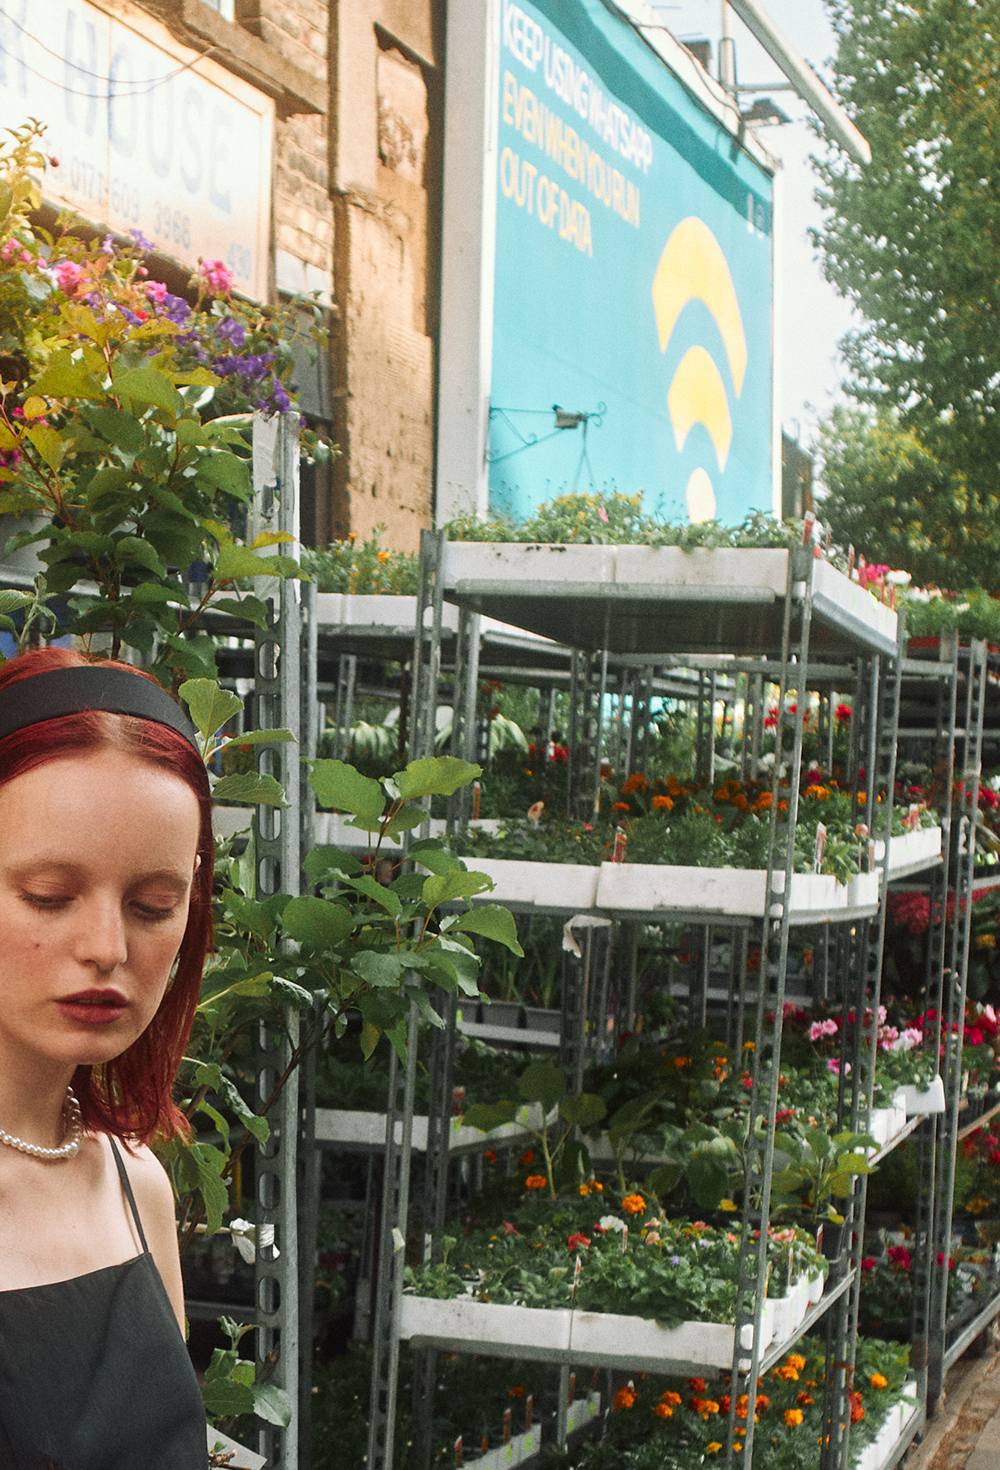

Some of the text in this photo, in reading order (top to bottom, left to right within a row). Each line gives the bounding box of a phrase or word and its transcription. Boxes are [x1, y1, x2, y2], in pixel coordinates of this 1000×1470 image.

[503, 0, 544, 72] KEEP
[63, 7, 235, 216] HOUSE
[503, 70, 545, 150] EVEN
[501, 147, 593, 258] OUT OF DATA
